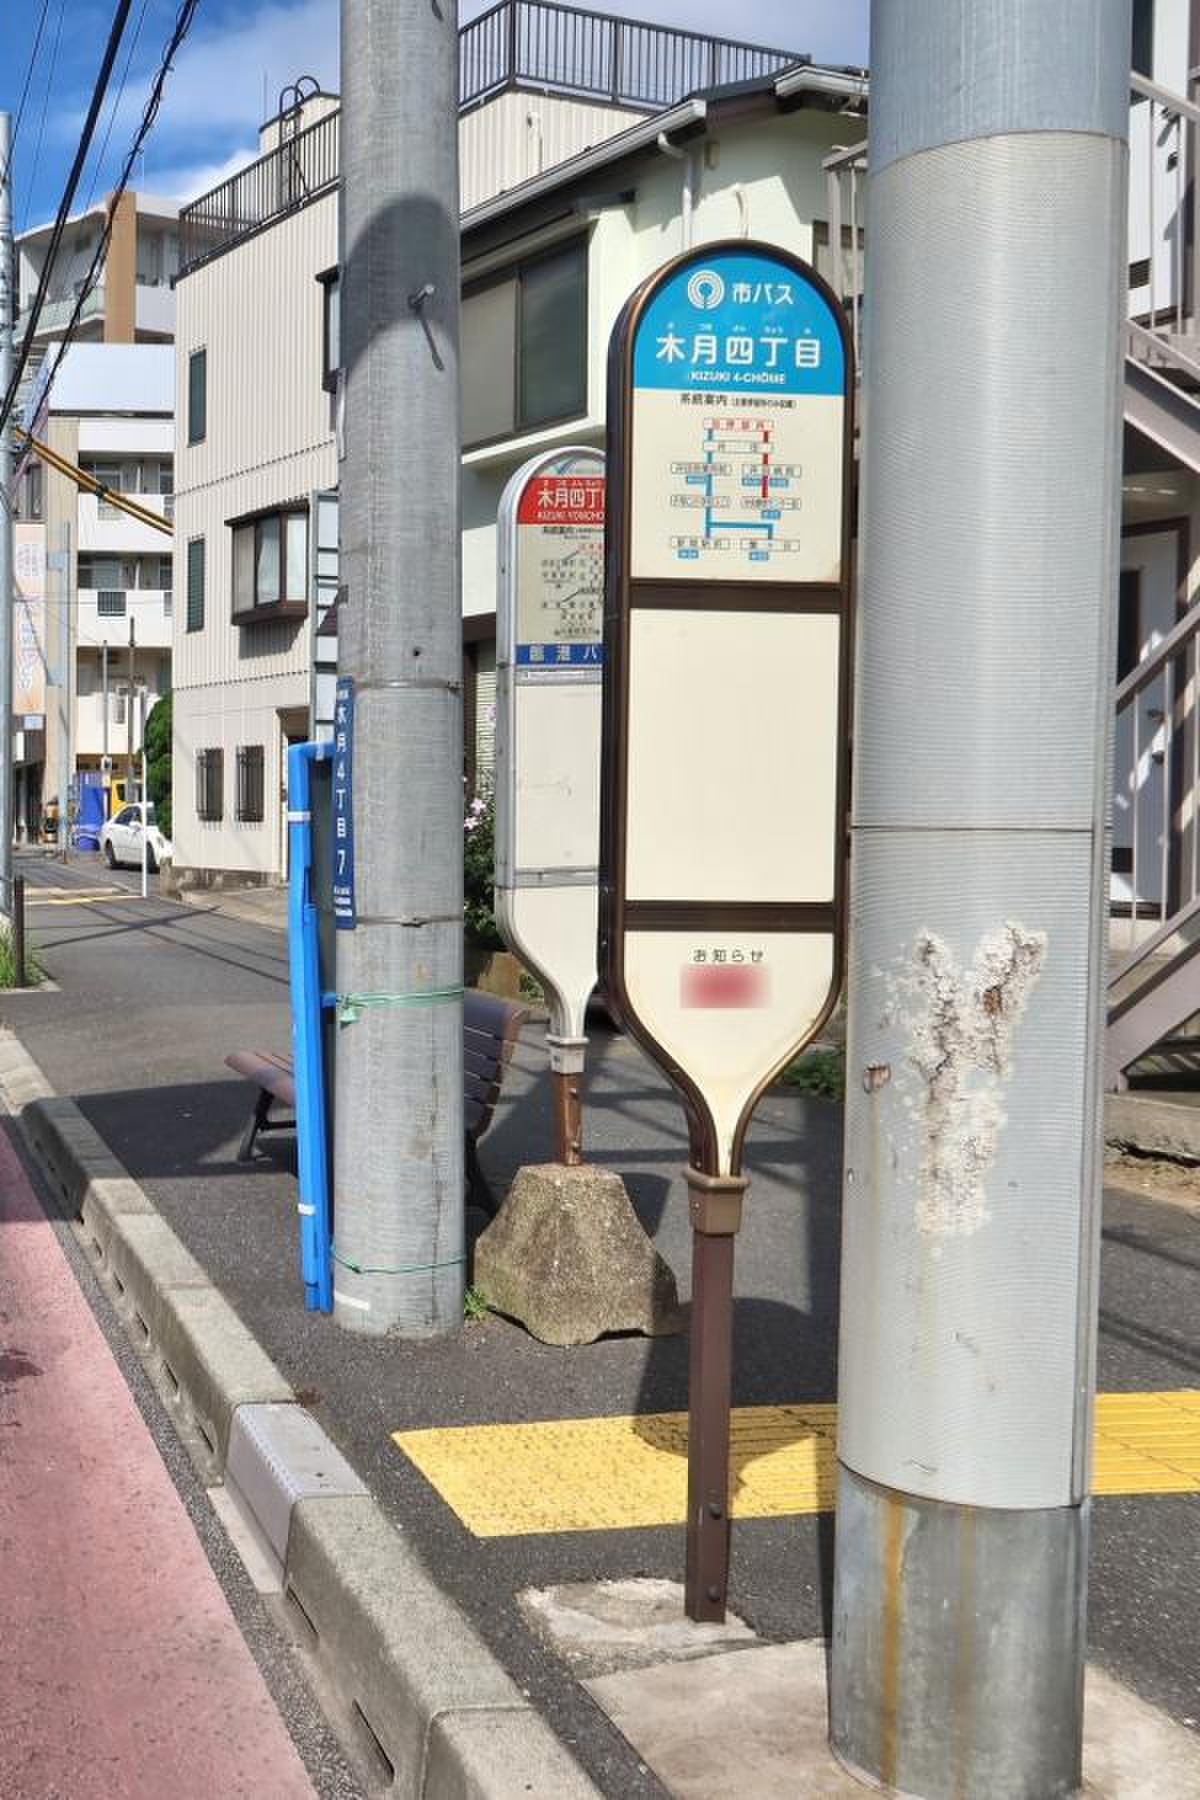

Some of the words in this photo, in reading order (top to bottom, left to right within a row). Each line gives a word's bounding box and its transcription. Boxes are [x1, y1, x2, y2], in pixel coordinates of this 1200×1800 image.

[732, 283, 794, 305] 市バス
[655, 332, 821, 368] 木月四丁目
[537, 486, 605, 509] 木月四丁
[693, 948, 764, 962] お知らせ
